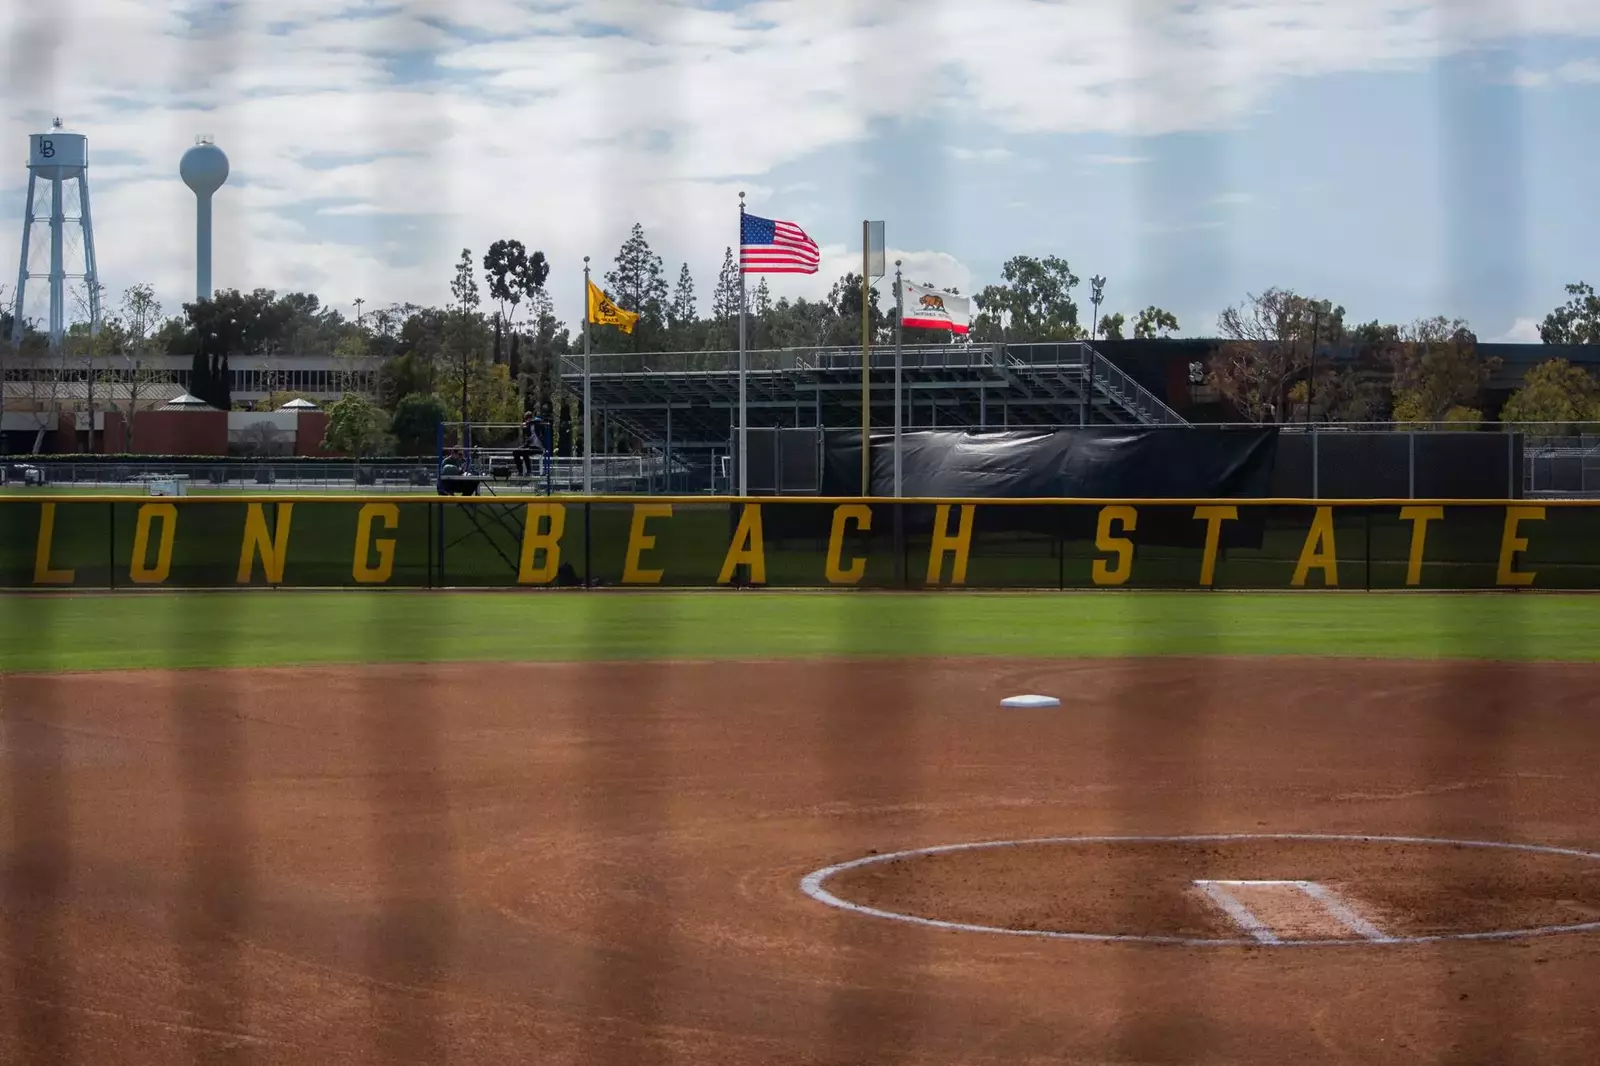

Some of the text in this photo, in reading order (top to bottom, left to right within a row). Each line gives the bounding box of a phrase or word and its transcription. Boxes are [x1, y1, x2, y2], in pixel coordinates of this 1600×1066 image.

[39, 136, 55, 158] LB
[34, 502, 1546, 586] LONG BEACH STATE
